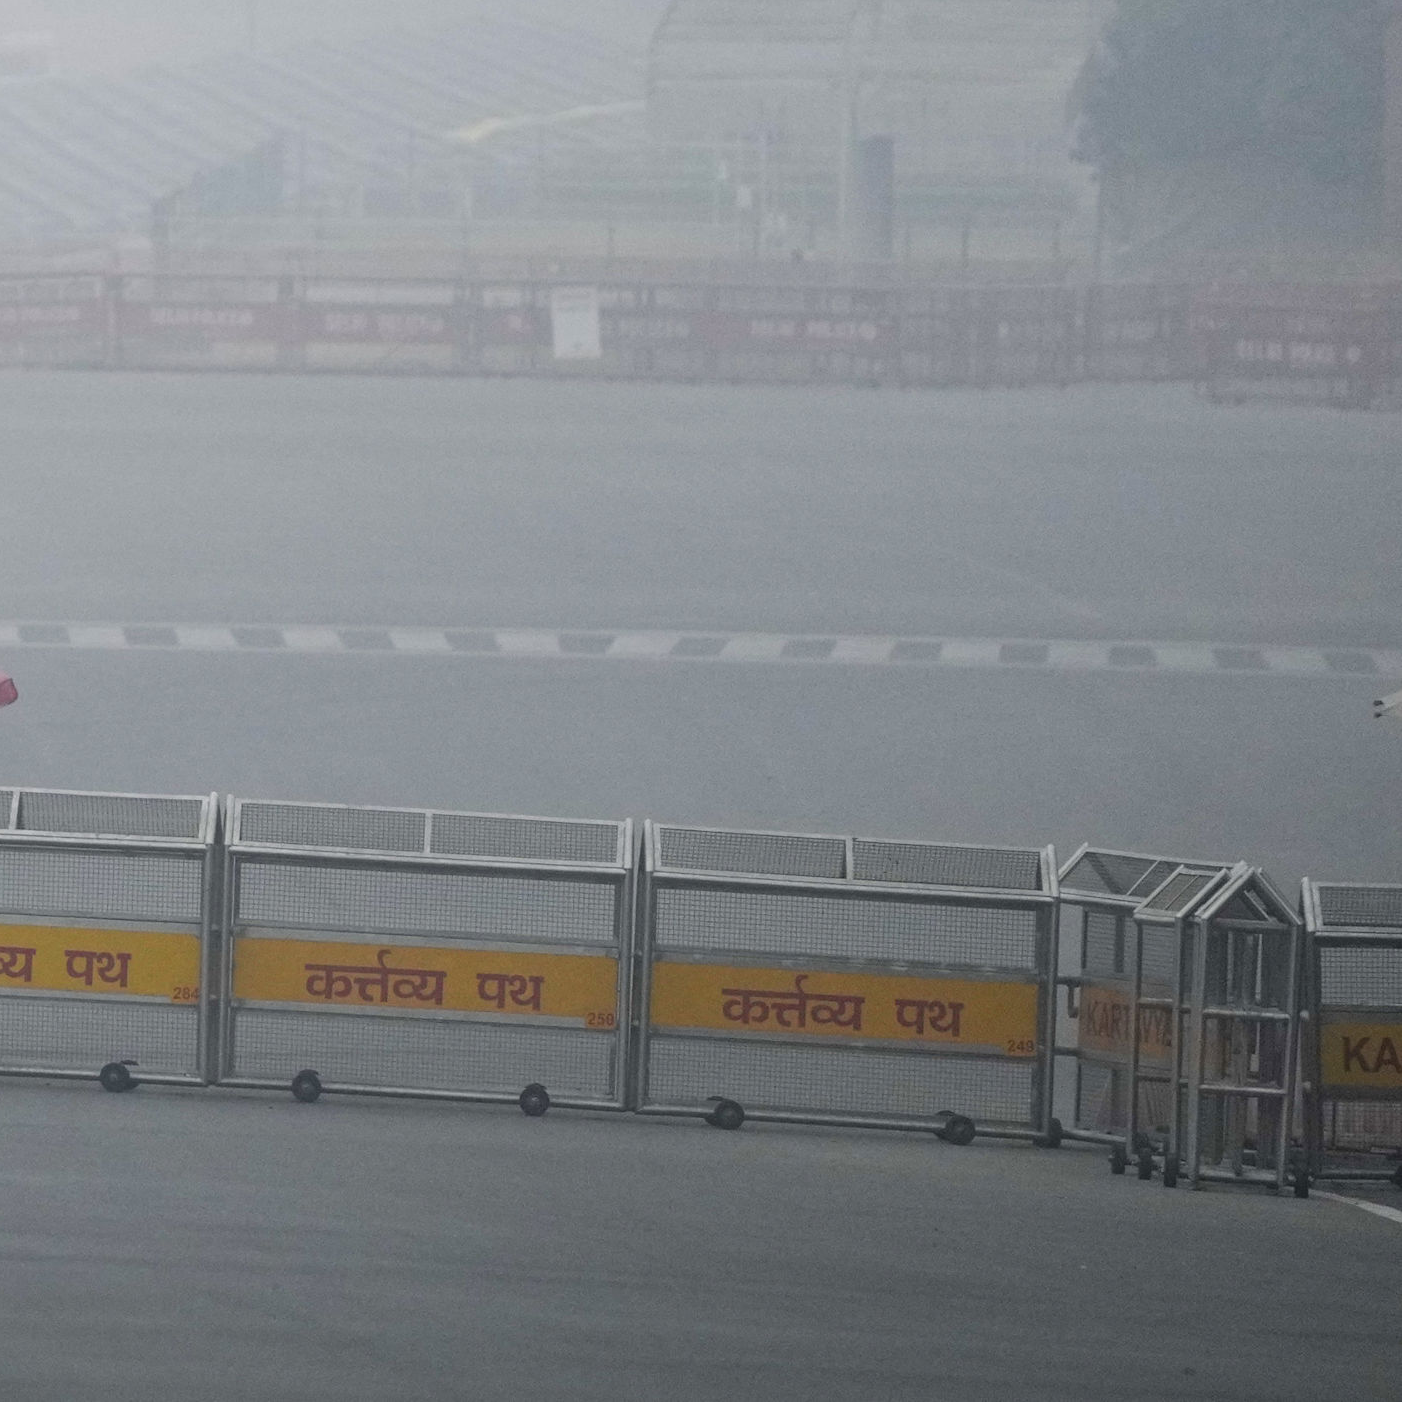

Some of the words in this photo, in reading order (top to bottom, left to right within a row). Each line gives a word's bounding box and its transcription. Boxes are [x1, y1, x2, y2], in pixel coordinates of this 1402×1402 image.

[65, 950, 132, 988] पथ
[477, 972, 544, 1010] पथ
[895, 998, 963, 1038] पथ
